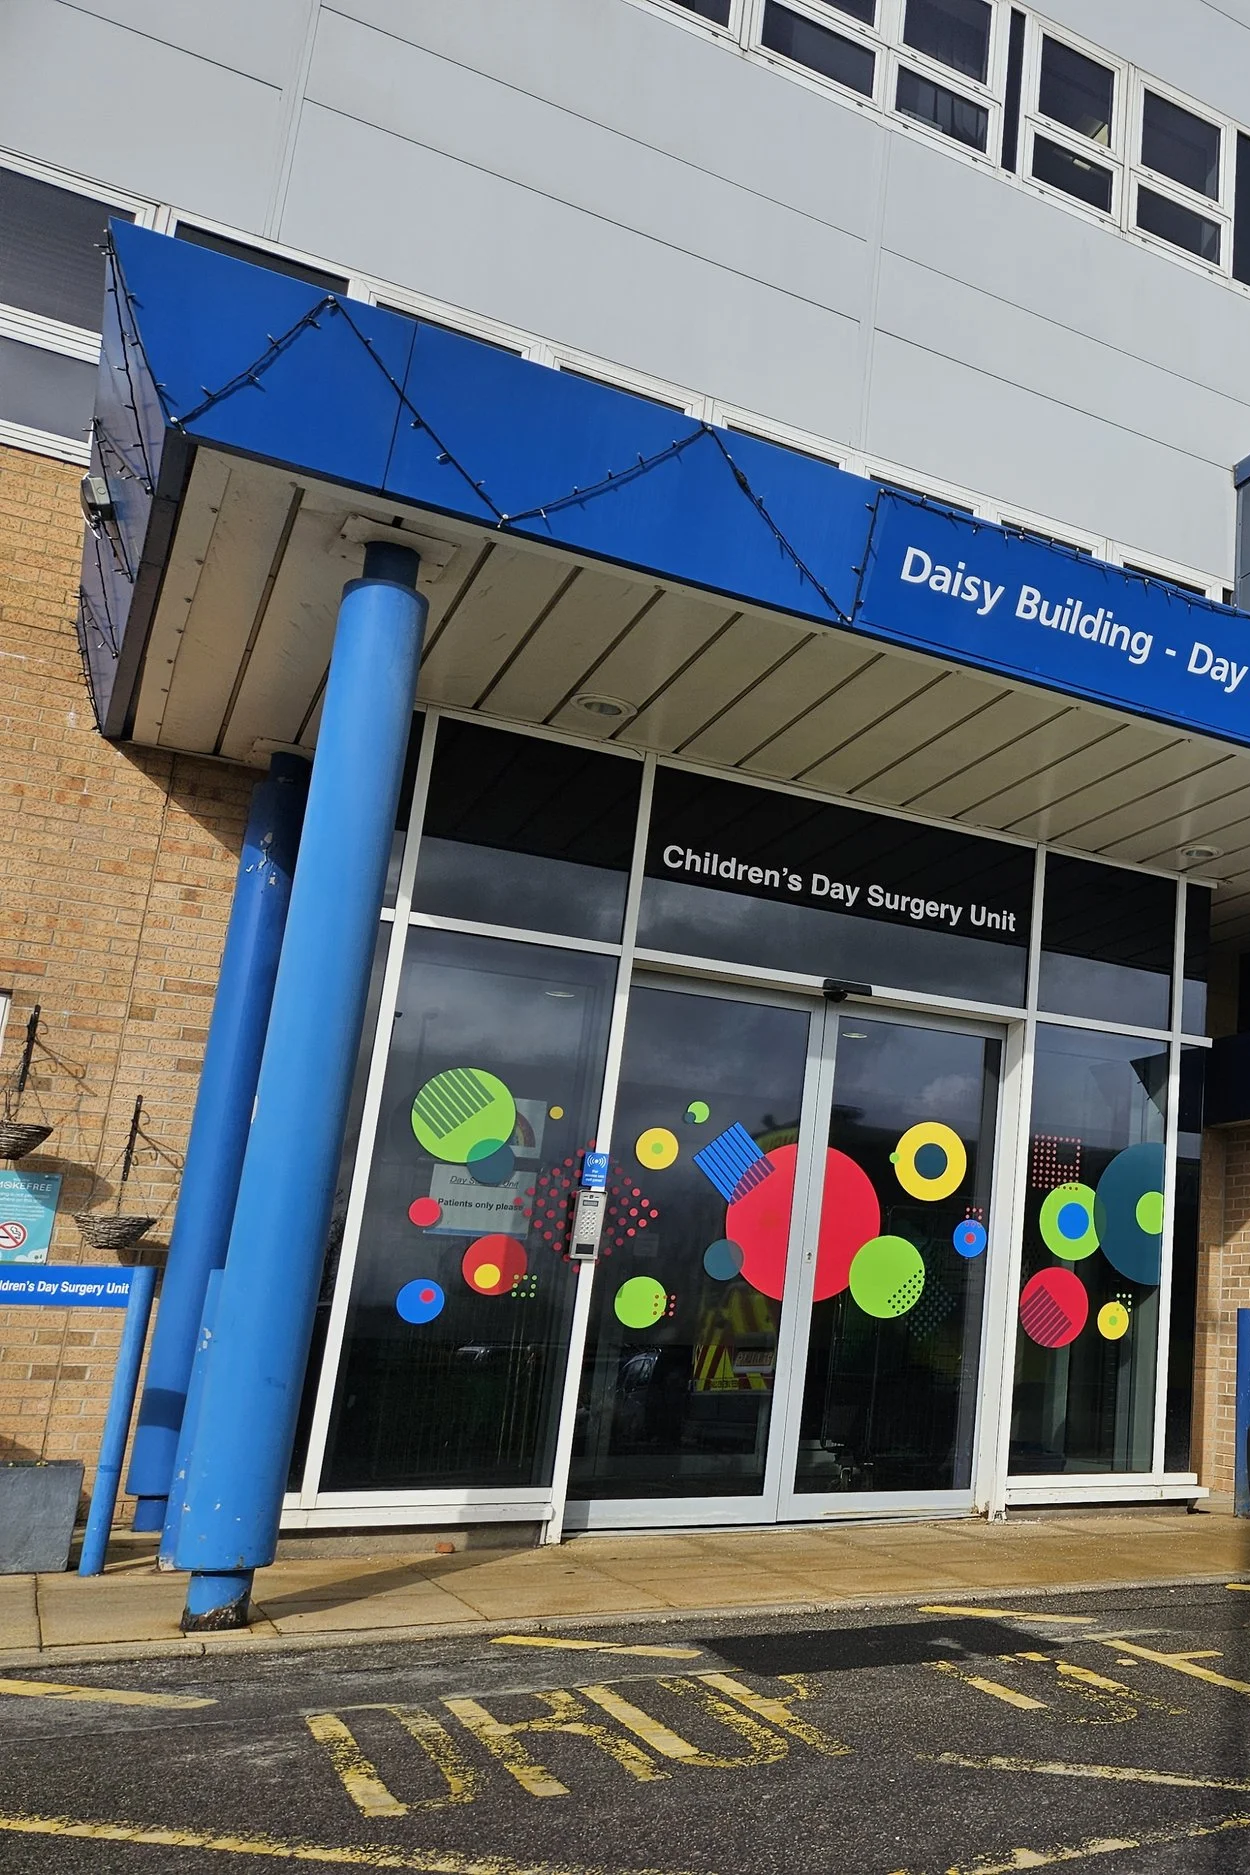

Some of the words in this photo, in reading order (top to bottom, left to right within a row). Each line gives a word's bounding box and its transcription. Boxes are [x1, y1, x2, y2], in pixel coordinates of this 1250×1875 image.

[900, 546, 1005, 616] Daisy
[1015, 584, 1154, 665] Building
[1165, 648, 1177, 657] -
[1187, 641, 1249, 693] Day
[663, 845, 803, 892] Children's
[811, 873, 860, 907] Day
[867, 884, 962, 927] Surgery
[970, 904, 1016, 932] Unit
[450, 1175, 467, 1185] Day
[438, 1198, 473, 1208] Patients
[475, 1201, 494, 1211] only
[495, 1201, 524, 1211] please
[37, 1280, 59, 1295] Day
[60, 1281, 104, 1296] Surgery
[106, 1282, 130, 1294] Unit
